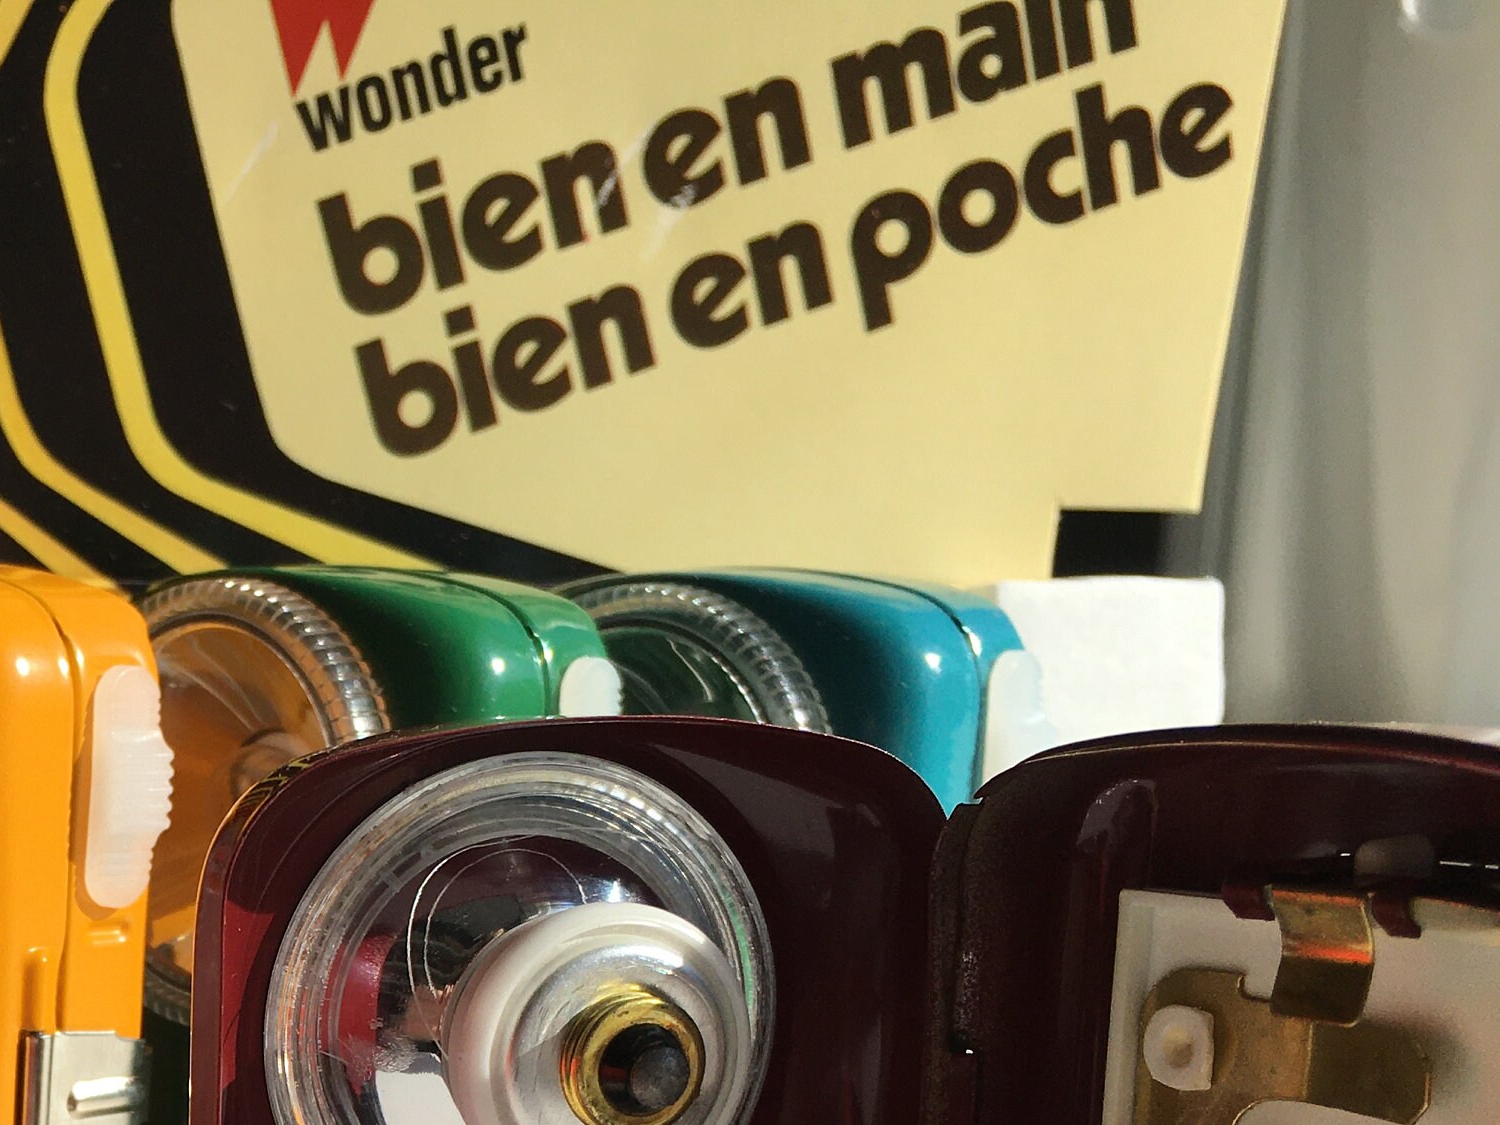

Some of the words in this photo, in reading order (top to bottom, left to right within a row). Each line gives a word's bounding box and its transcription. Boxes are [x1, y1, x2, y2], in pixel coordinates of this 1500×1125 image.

[294, 24, 528, 152] wonder
[316, 158, 630, 317] bien
[642, 75, 812, 208] en
[830, 0, 1138, 149] main
[354, 282, 656, 458] bien
[670, 221, 834, 350] en
[850, 82, 1234, 333] poche
